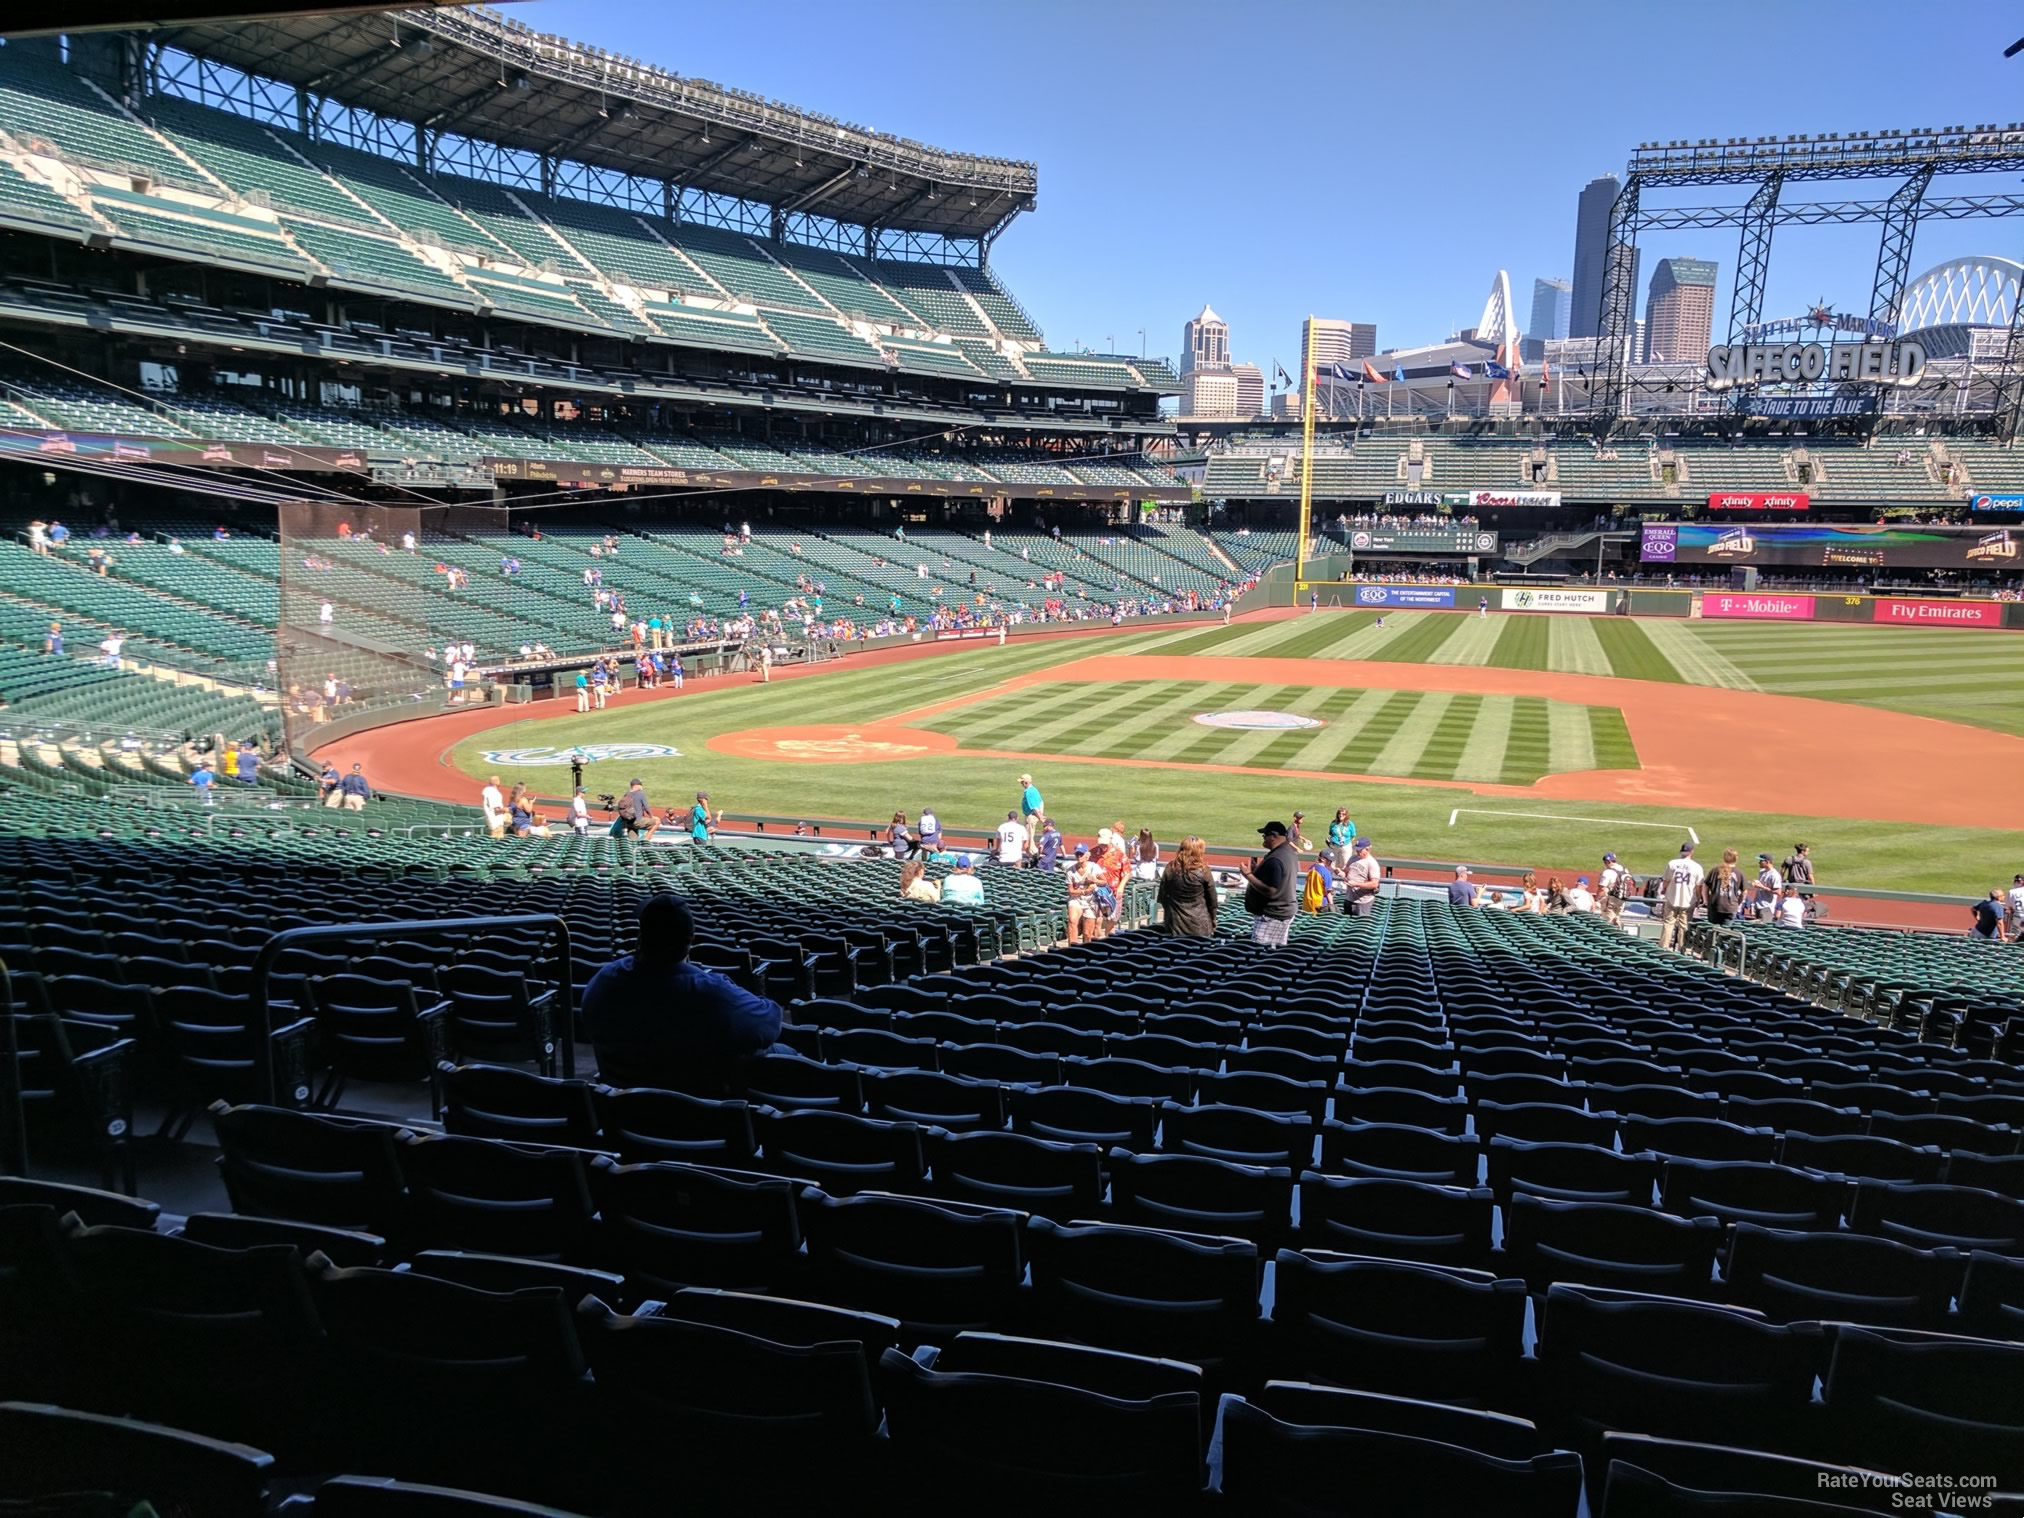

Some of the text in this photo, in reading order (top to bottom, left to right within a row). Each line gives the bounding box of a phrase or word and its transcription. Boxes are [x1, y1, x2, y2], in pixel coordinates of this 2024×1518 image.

[1743, 313, 1897, 342] SEATTLE MARINERS
[1705, 341, 1926, 393] SAFECO FIELD
[1762, 398, 1865, 415] TRUE TO THE BLUE
[493, 463, 518, 475] 11:19
[621, 468, 647, 477] MARINERS
[647, 469, 663, 478] TEAM
[663, 470, 686, 478] STORES
[1385, 492, 1442, 505] EDGARS
[1476, 492, 1517, 506] Coors
[1721, 496, 1754, 507] xfinity
[1764, 496, 1797, 508] xfinity
[1992, 498, 2023, 508] pepsi
[1643, 541, 1675, 554] EQC
[1725, 537, 1753, 553] FIELD
[1986, 541, 2016, 557] FIELD
[1830, 554, 1867, 563] WELCOME
[1361, 590, 1387, 600] EQC
[1845, 597, 1861, 605] 376
[1891, 604, 1982, 619] Fly Emirates
[1003, 831, 1014, 843] 15
[1053, 838, 1058, 849] 2
[1674, 871, 1691, 885] 24
